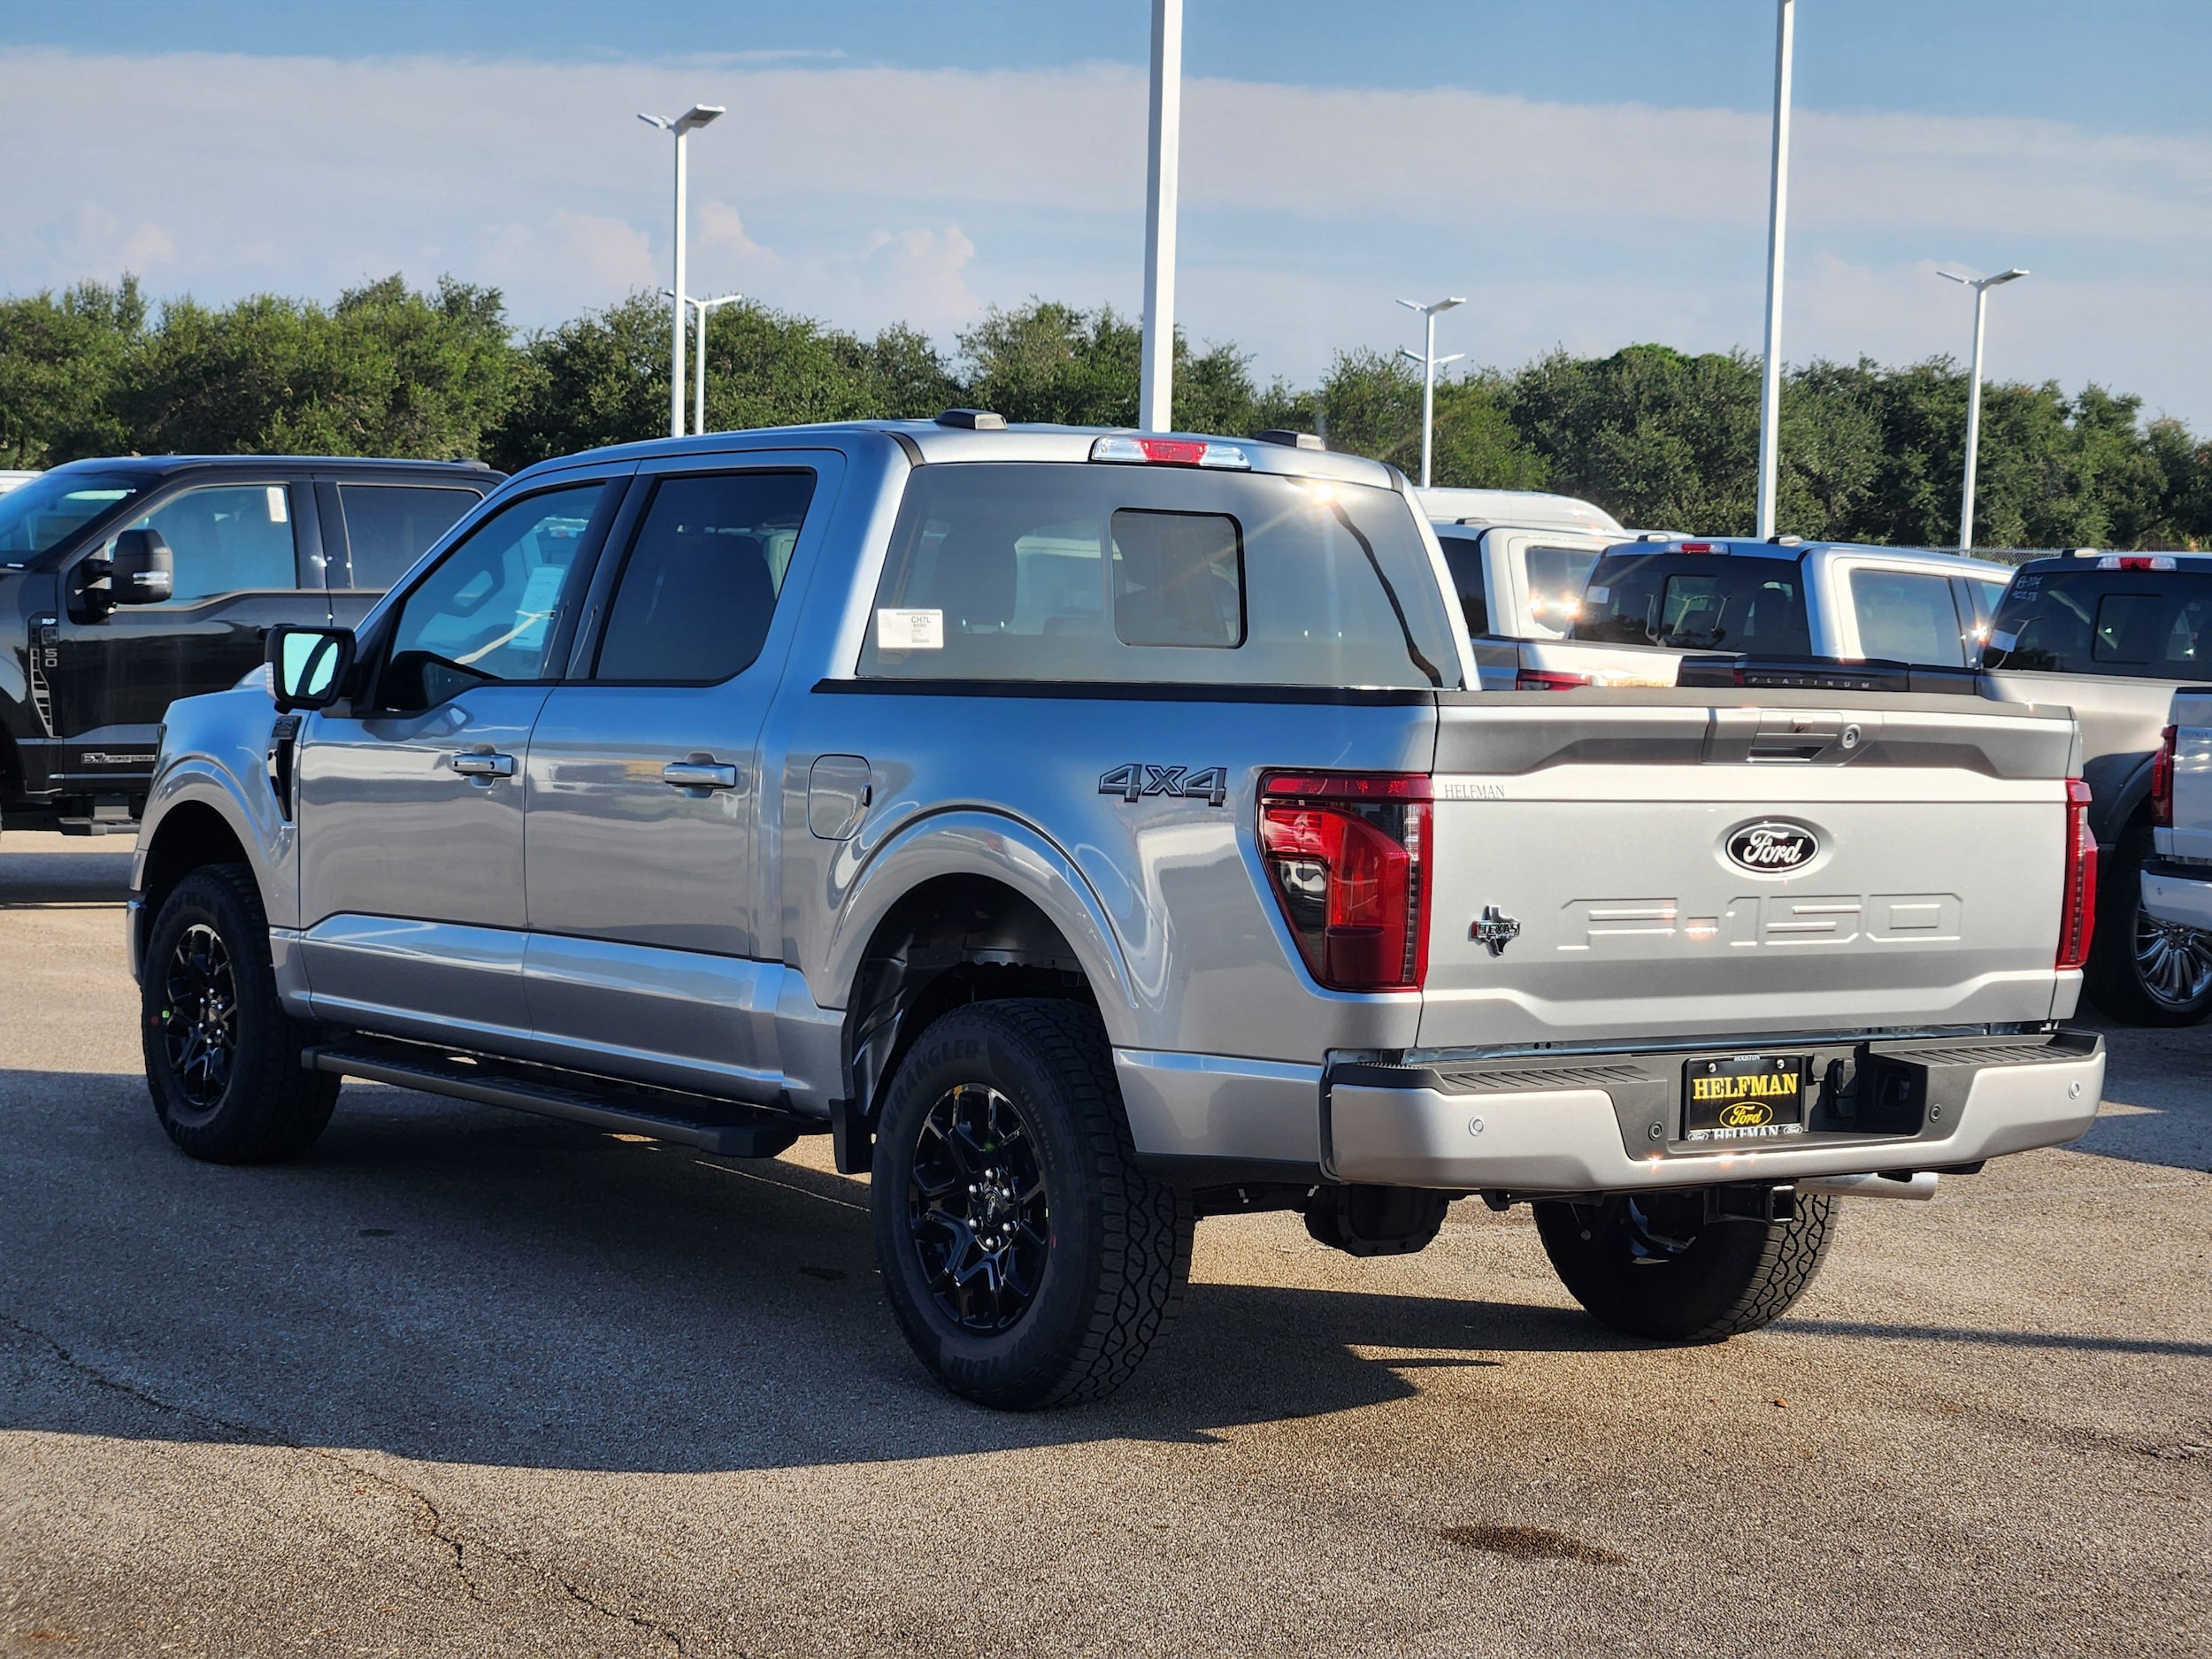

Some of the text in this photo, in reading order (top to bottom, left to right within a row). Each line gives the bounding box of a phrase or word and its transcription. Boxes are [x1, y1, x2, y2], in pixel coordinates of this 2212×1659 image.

[1751, 677, 1870, 688] PLATINUM
[1444, 784, 1506, 800] HELFMAN
[1743, 829, 1805, 864] Ford
[1479, 923, 1518, 937] TEXAS
[1556, 893, 1964, 951] F-150
[1693, 1072, 1799, 1100] HELFMAN
[1712, 1125, 1780, 1141] HELFMAN
